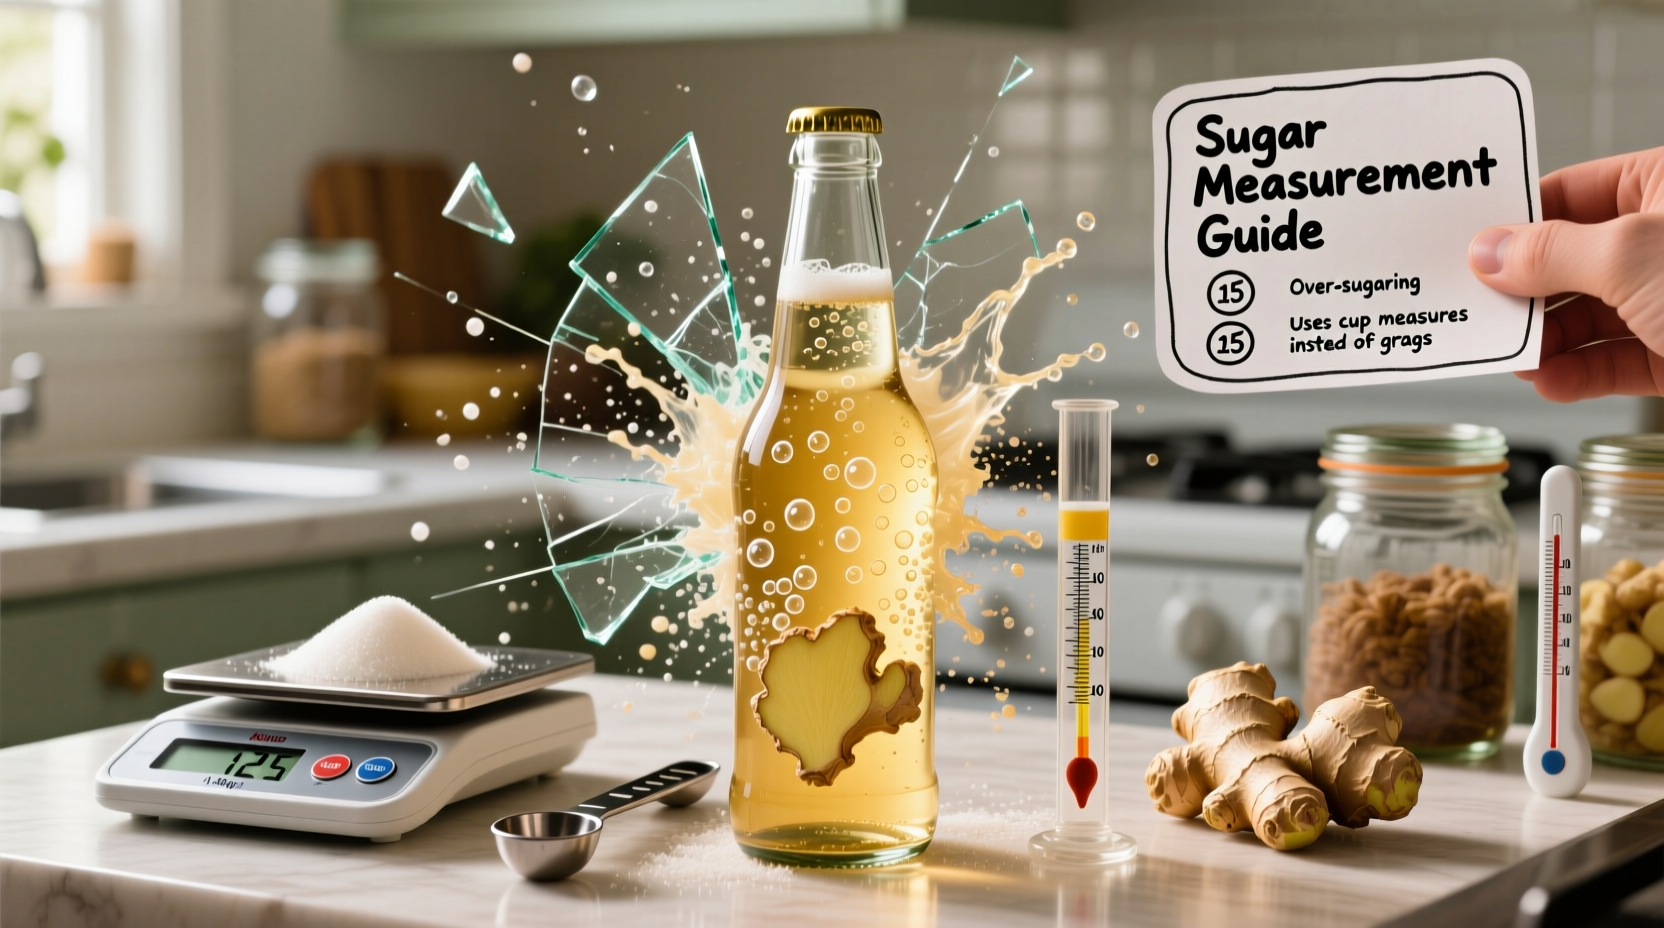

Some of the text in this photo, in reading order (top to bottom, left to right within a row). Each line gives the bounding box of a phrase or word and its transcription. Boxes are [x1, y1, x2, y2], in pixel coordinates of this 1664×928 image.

[1196, 114, 1327, 168] Sugar
[1194, 147, 1497, 207] Measurement
[1198, 209, 1324, 257] Guide
[1217, 279, 1245, 304] 15
[1289, 273, 1420, 298] Over-sugaring
[1289, 308, 1468, 333] Uses cup measures
[1217, 330, 1245, 355] 15
[1290, 331, 1433, 355] insted of grags
[224, 751, 293, 781] 125
